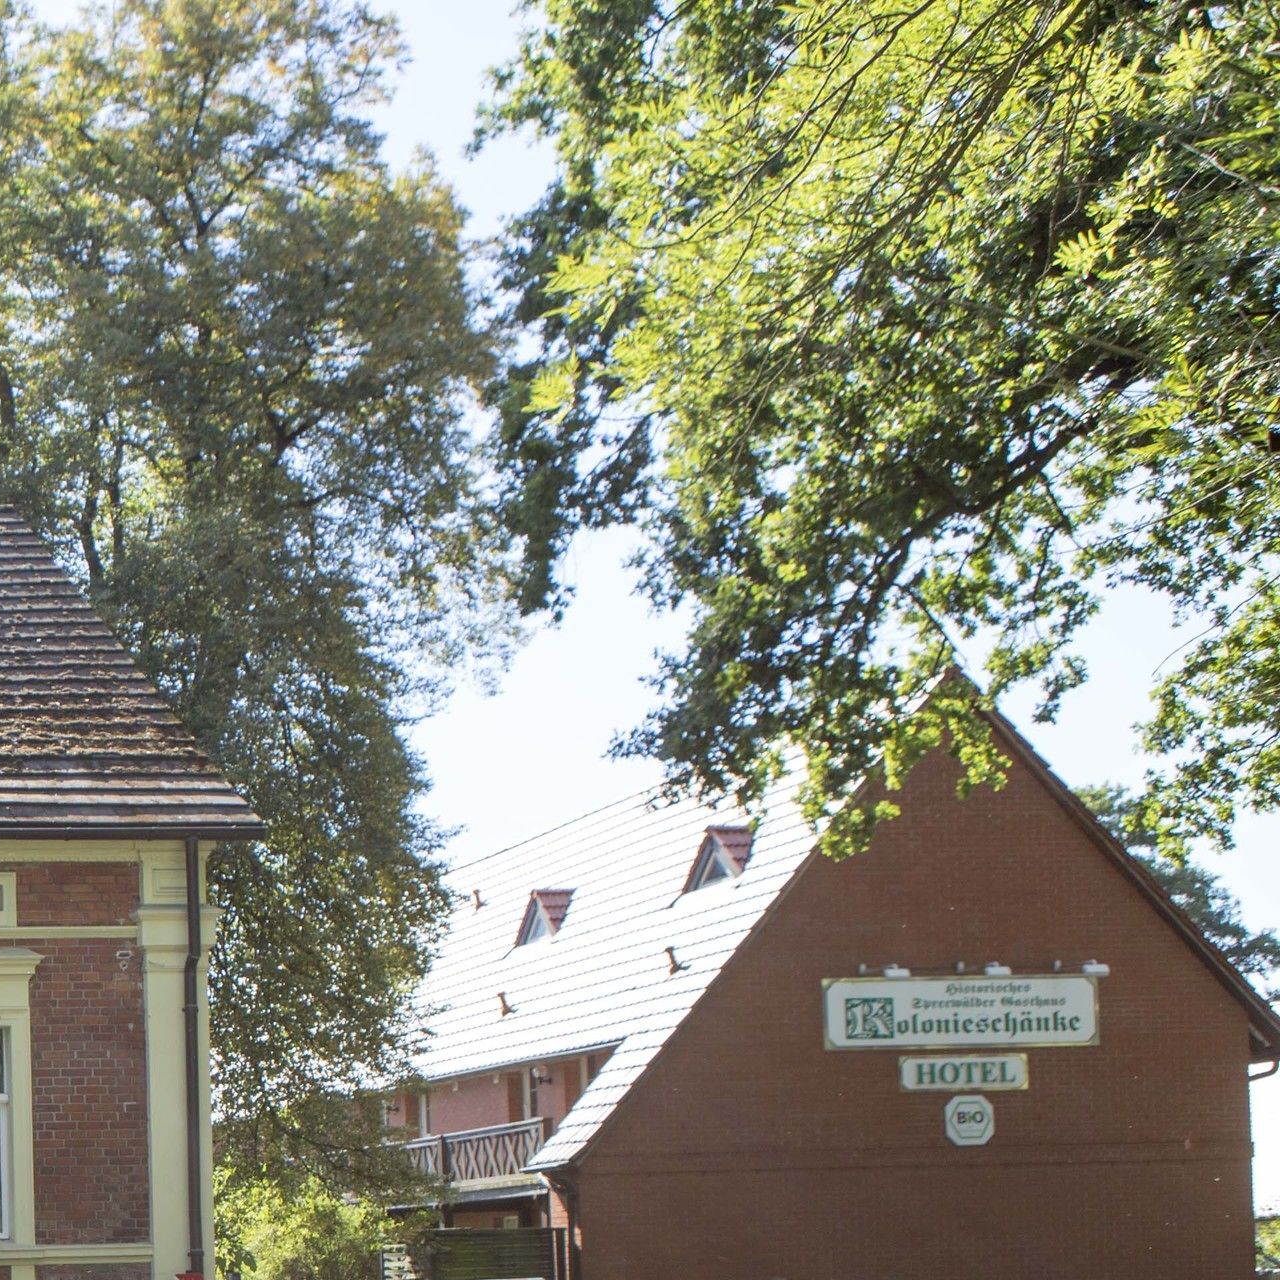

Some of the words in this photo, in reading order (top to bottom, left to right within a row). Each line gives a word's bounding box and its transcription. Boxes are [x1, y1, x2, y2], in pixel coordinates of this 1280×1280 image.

[946, 982, 1032, 995] Historisches
[912, 997, 997, 1010] Spreewälder
[1001, 995, 1067, 1009] Gasthaus
[845, 998, 1081, 1039] Kolonieschänke
[916, 1061, 1017, 1085] HOTEL
